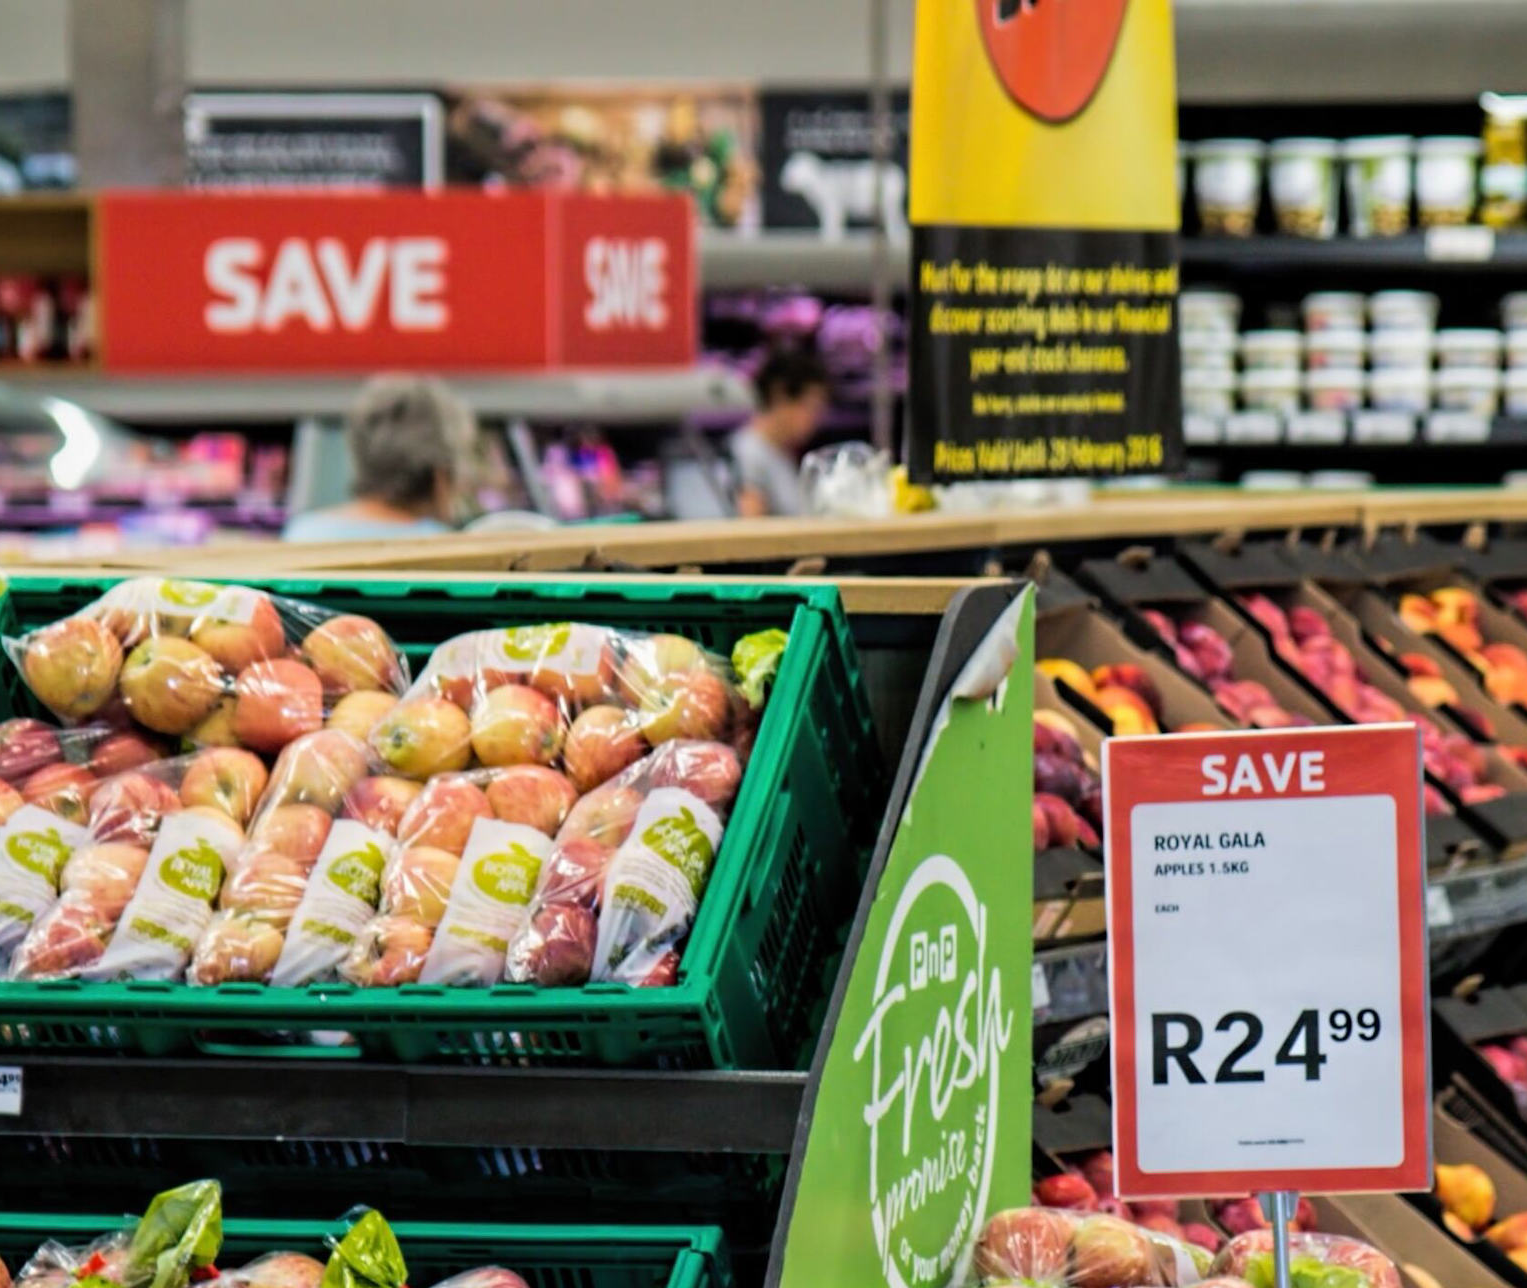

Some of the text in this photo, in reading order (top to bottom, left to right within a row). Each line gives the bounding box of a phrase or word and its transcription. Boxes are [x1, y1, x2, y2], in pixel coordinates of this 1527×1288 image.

[203, 236, 451, 333] SAVE
[583, 235, 669, 332] SAVE
[934, 439, 975, 474] Prices
[977, 437, 1012, 473] Valid
[1201, 750, 1326, 796] SAVE
[1154, 832, 1266, 852] ROYAL GALA
[1154, 860, 1250, 877] APPLES 1.5KG
[1154, 903, 1180, 914] EACH
[910, 924, 957, 990] PnP
[854, 902, 1014, 1156] Fresh
[883, 1129, 967, 1277] promise
[900, 1103, 987, 1286] or your money back
